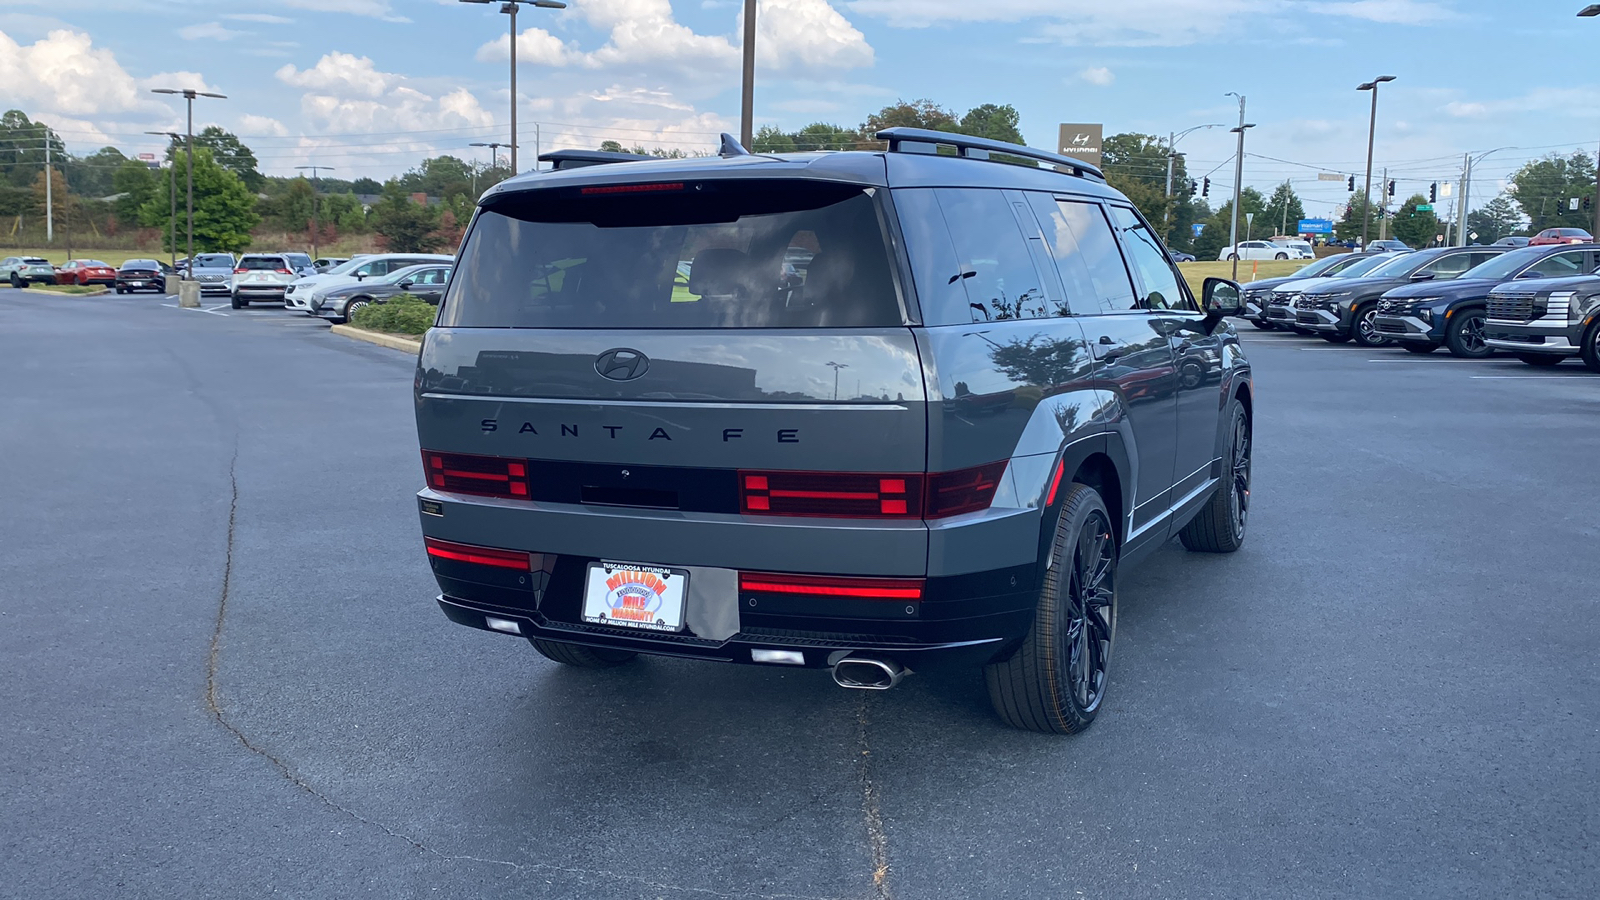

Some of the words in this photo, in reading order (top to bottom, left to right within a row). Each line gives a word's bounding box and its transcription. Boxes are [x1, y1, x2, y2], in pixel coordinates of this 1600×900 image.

[481, 418, 672, 441] SANTA
[722, 428, 800, 443] FE
[603, 563, 640, 571] TUSCALOOSA
[606, 571, 667, 596] MILLION
[623, 595, 646, 610] MILE
[611, 608, 654, 621] WARRANTY
[639, 623, 675, 631] HYUNDAI.COM
